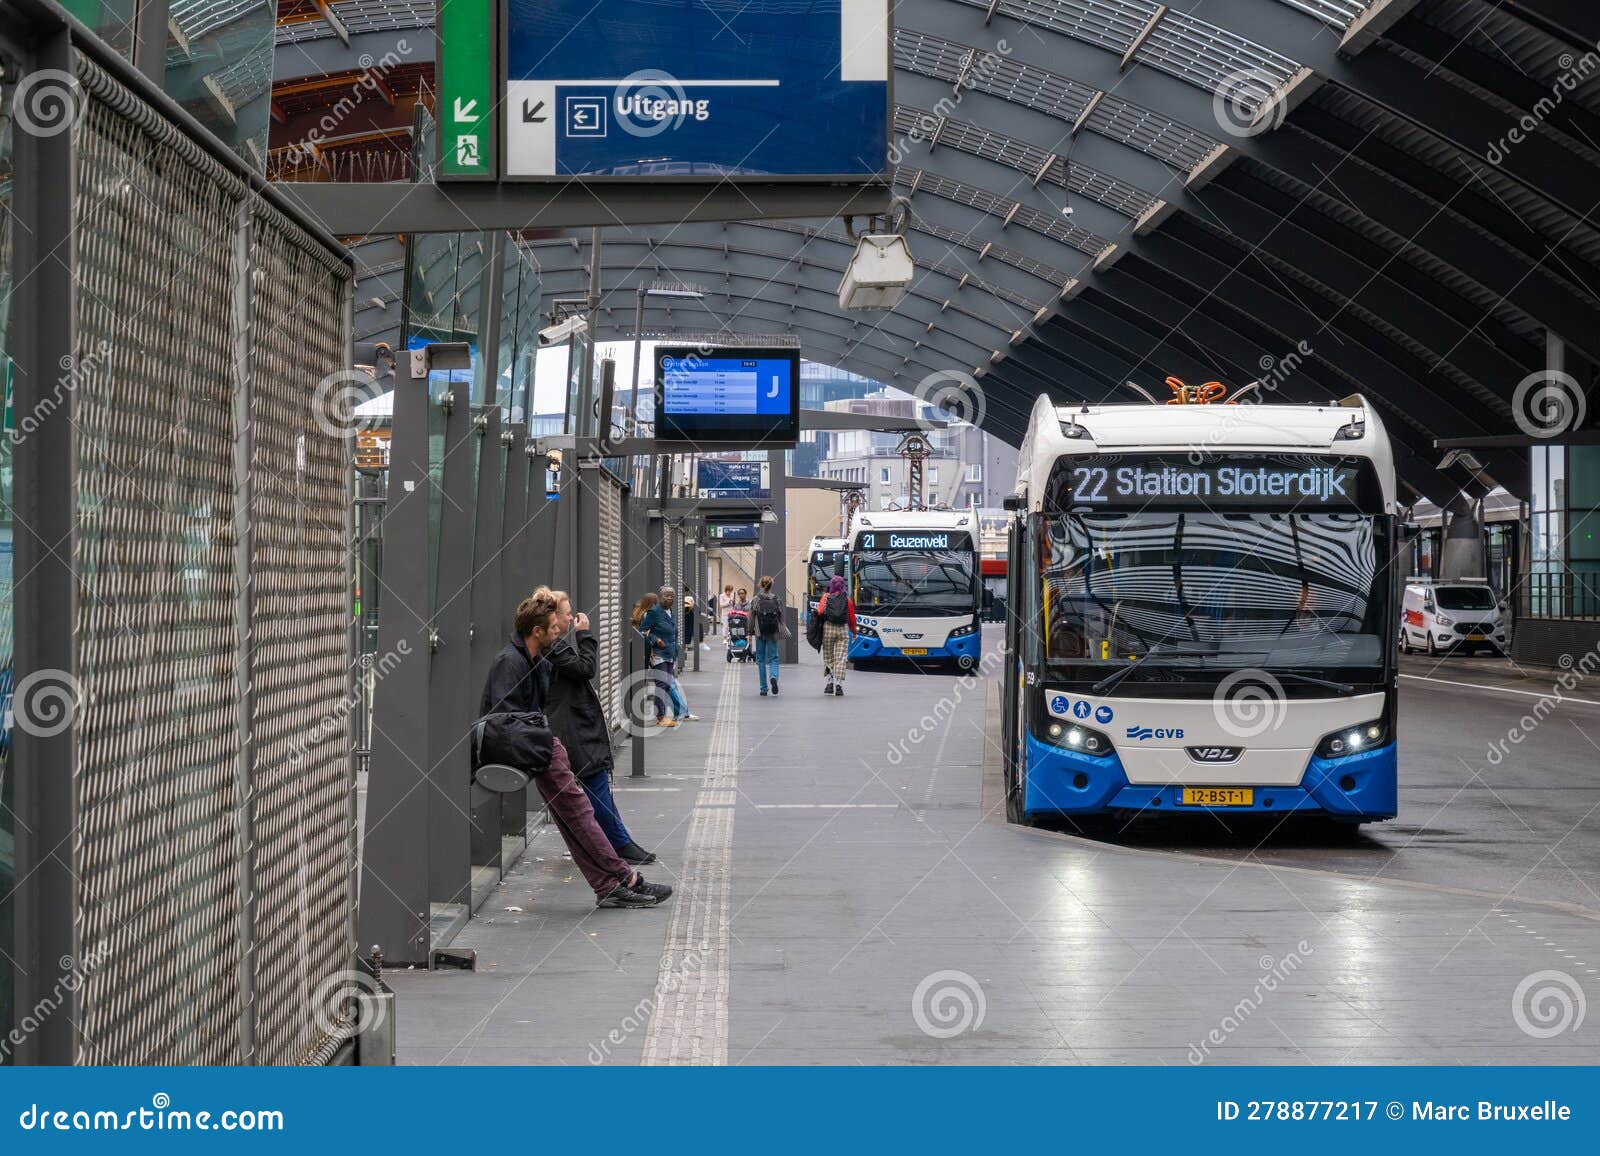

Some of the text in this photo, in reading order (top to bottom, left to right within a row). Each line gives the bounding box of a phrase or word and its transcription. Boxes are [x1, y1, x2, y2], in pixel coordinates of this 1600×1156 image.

[616, 95, 710, 121] Uitgang
[766, 375, 780, 399] J
[1073, 466, 1347, 502] 22 Station Sloterdijk
[863, 534, 948, 548] 21 Geuzenveld
[1154, 728, 1185, 739] GVB
[1193, 747, 1235, 760] VDL
[1191, 790, 1244, 803] 12-BST-1
